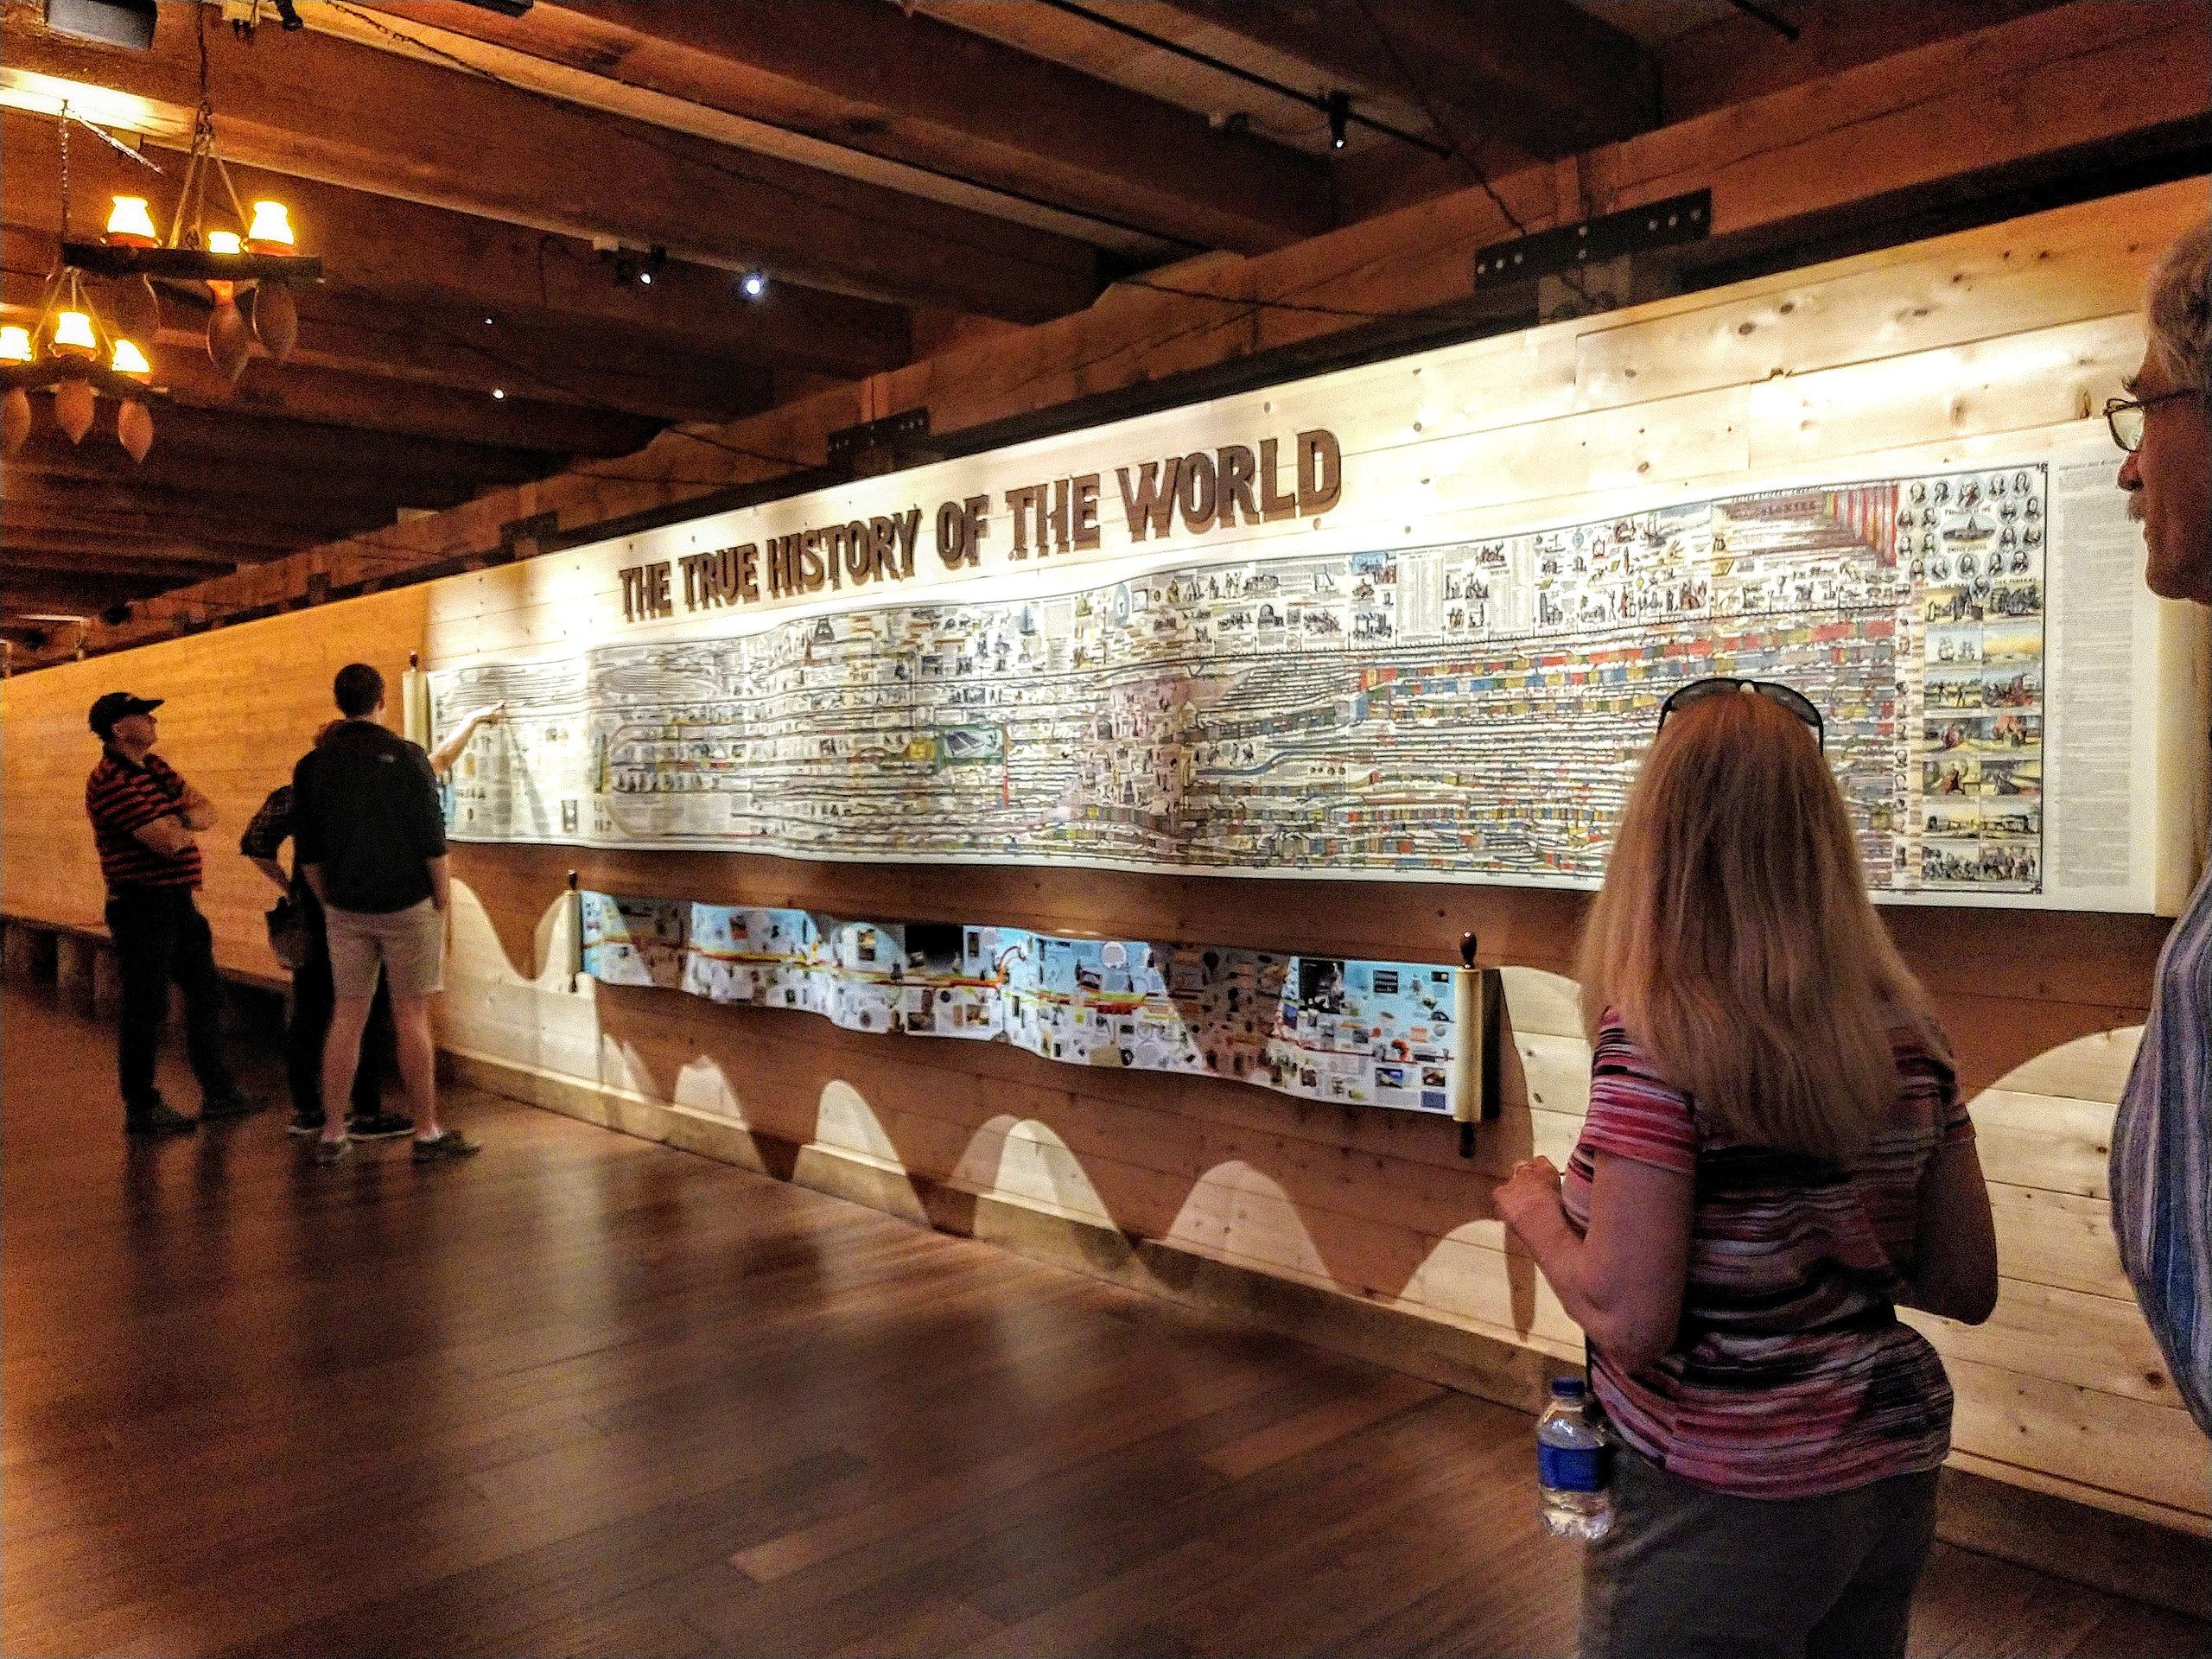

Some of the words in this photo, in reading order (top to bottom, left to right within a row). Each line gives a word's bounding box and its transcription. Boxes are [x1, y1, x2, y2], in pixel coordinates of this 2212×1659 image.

[619, 561, 674, 622] THE
[678, 543, 760, 613] TRUE
[766, 508, 924, 601] HISTORY
[935, 494, 991, 570] OF
[1006, 474, 1102, 561] THE
[1116, 429, 1343, 543] WORLD
